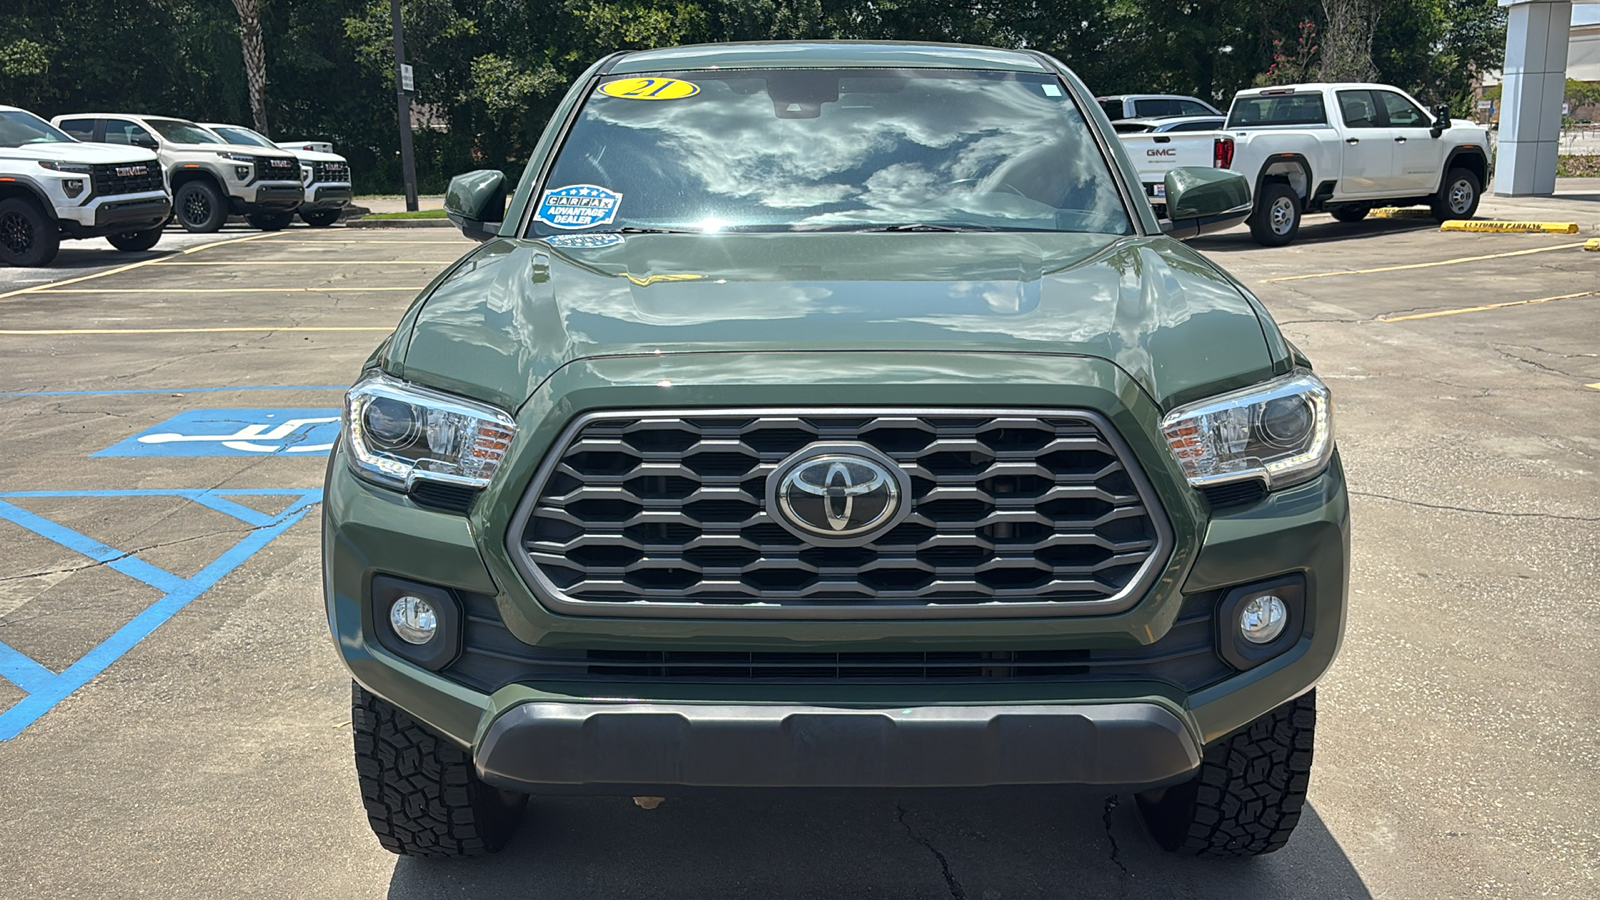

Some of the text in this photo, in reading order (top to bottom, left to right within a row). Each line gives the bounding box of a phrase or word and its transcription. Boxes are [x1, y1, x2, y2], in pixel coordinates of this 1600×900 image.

[621, 80, 666, 97] 21
[1147, 148, 1176, 157] GMC
[115, 165, 148, 177] GMC
[547, 196, 611, 208] CARFAX
[547, 207, 607, 218] ADVANTAGE
[553, 215, 592, 225] DEALER
